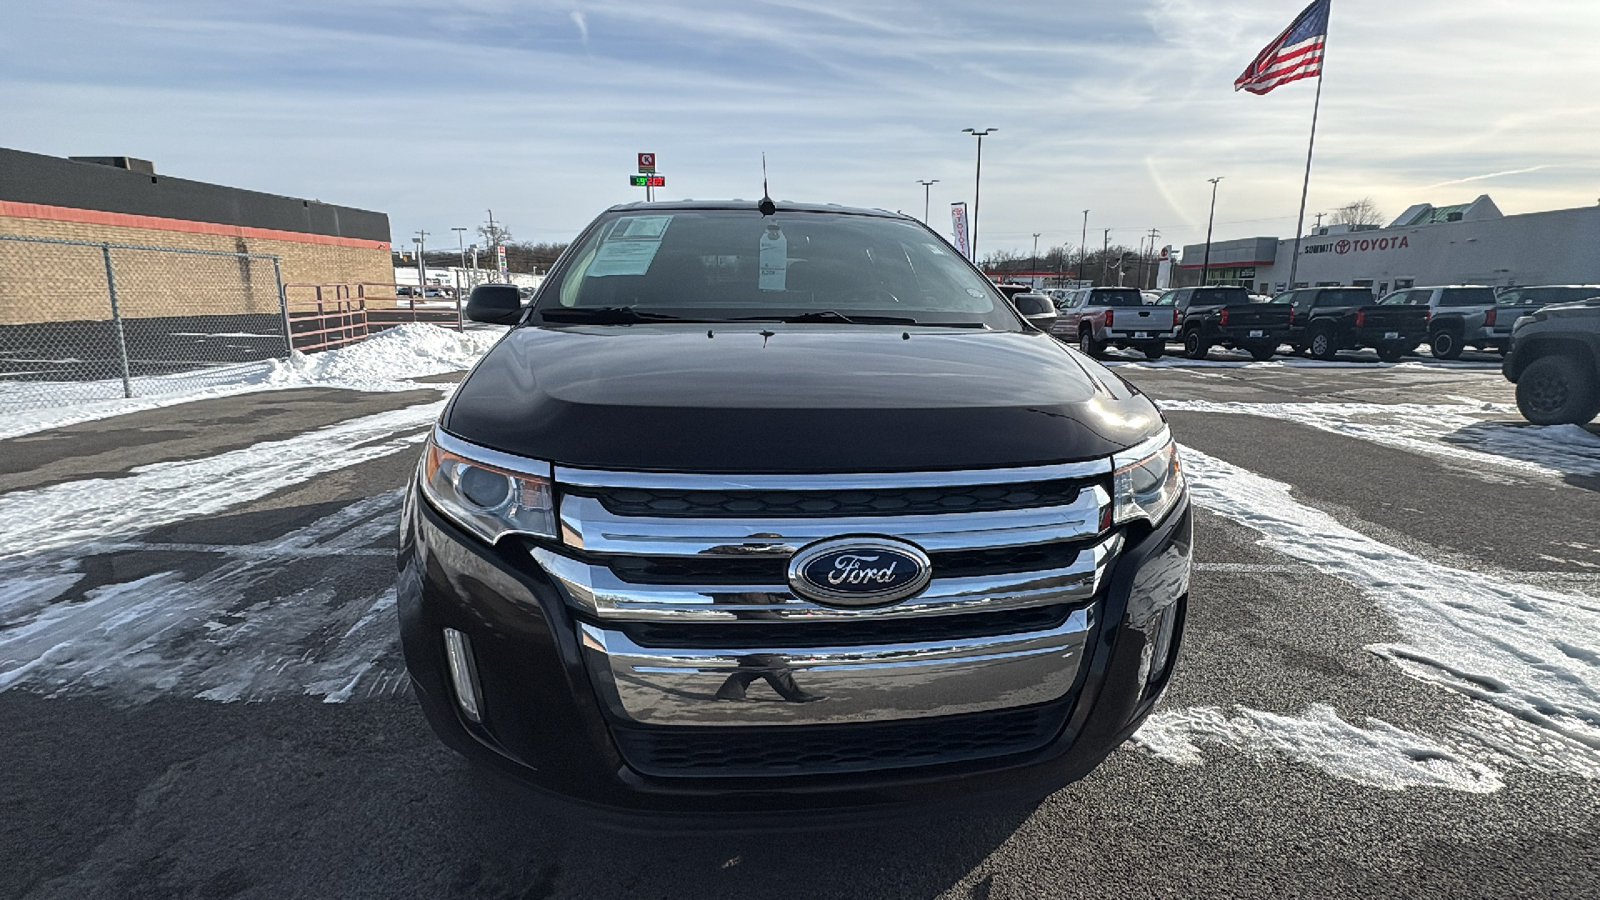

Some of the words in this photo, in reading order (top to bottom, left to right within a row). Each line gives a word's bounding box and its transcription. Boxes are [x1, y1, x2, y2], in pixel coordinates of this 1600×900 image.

[1304, 243, 1334, 254] SUMMIT
[1352, 236, 1409, 252] TOYOTA
[827, 554, 898, 585] Ford
